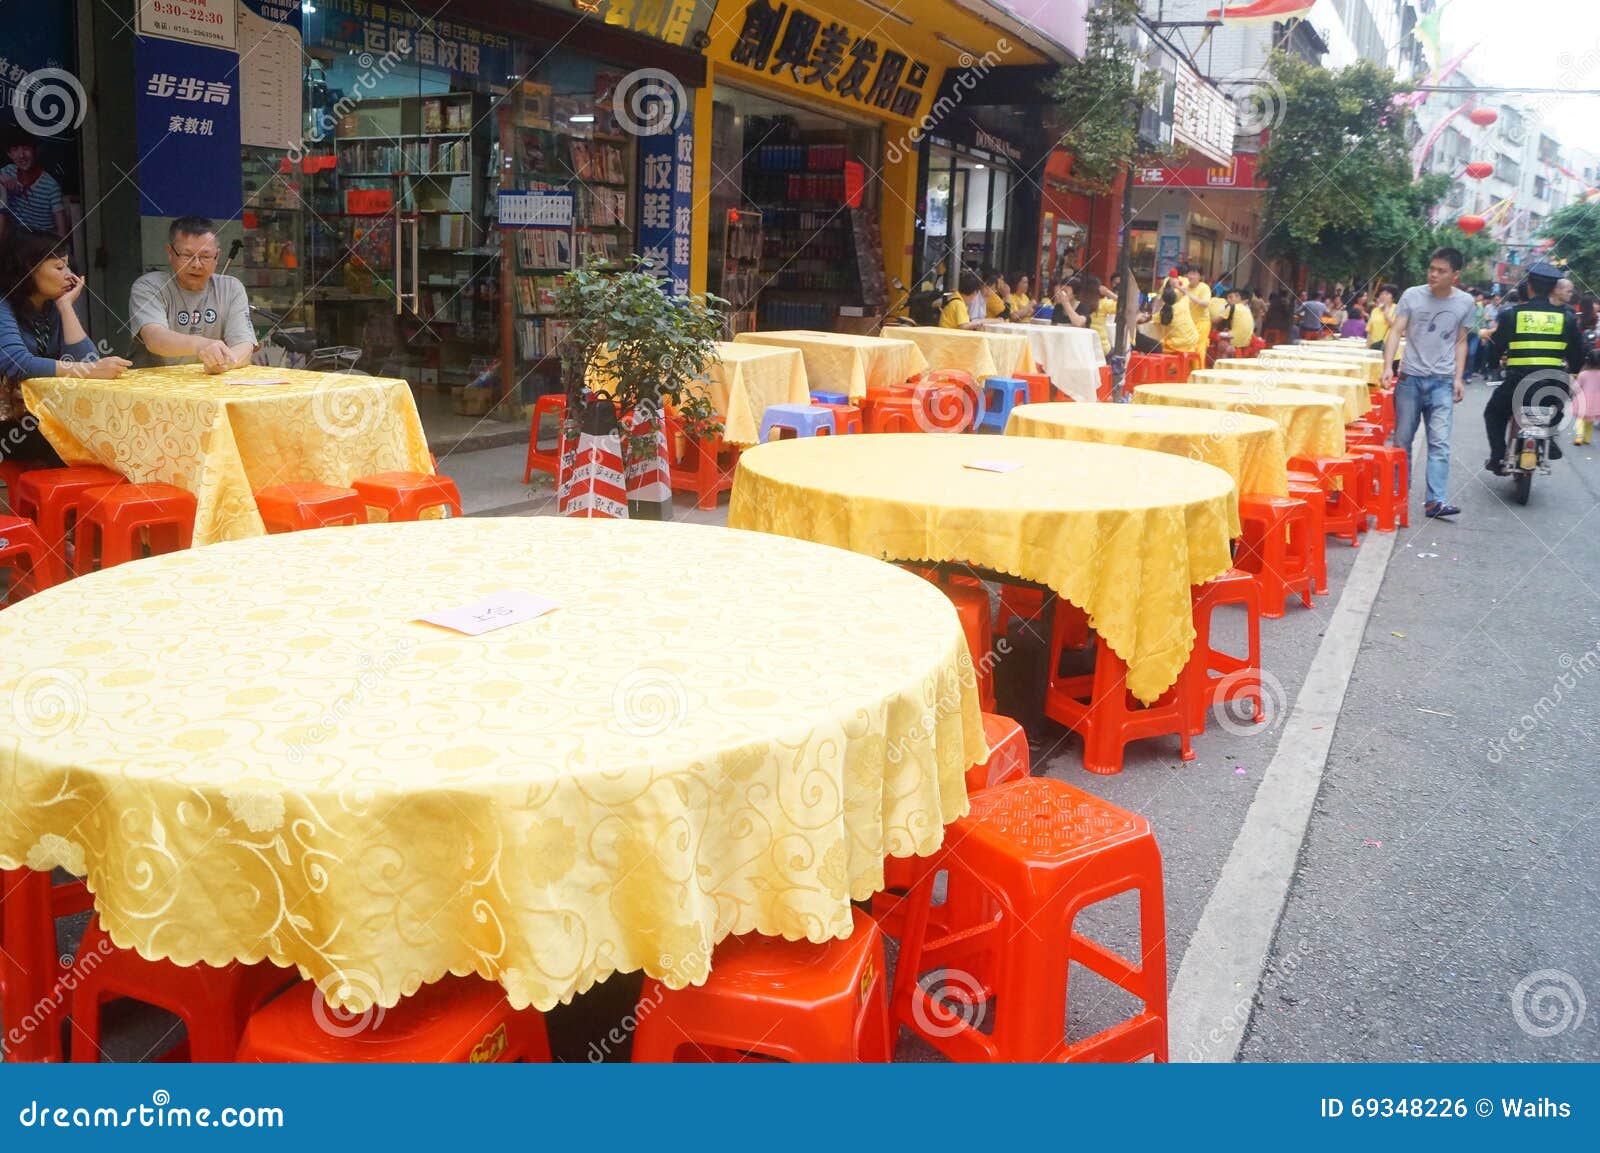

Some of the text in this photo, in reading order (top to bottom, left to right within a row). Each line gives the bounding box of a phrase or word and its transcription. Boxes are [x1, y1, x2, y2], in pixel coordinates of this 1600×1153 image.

[146, 73, 232, 106] 步步高
[168, 115, 214, 136] 家教机
